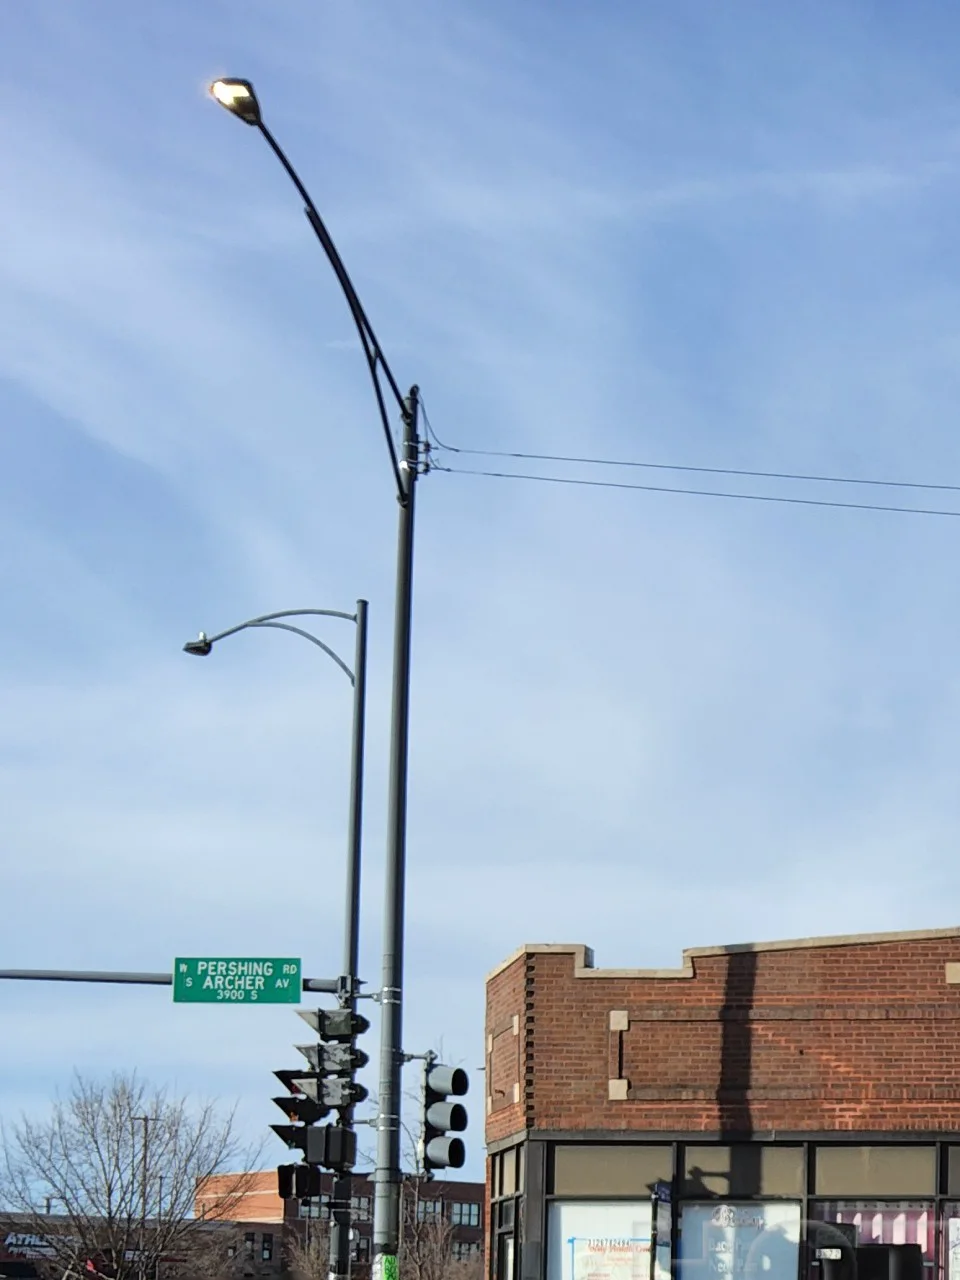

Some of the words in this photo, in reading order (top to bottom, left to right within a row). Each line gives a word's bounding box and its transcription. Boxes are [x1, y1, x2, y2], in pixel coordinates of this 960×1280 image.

[179, 963, 188, 973] W
[197, 961, 273, 976] PERSHING
[282, 964, 297, 975] RD
[185, 977, 193, 987] S
[202, 975, 265, 990] ARCHER
[274, 979, 290, 989] AV
[216, 989, 244, 1000] 3900
[250, 990, 258, 1000] S
